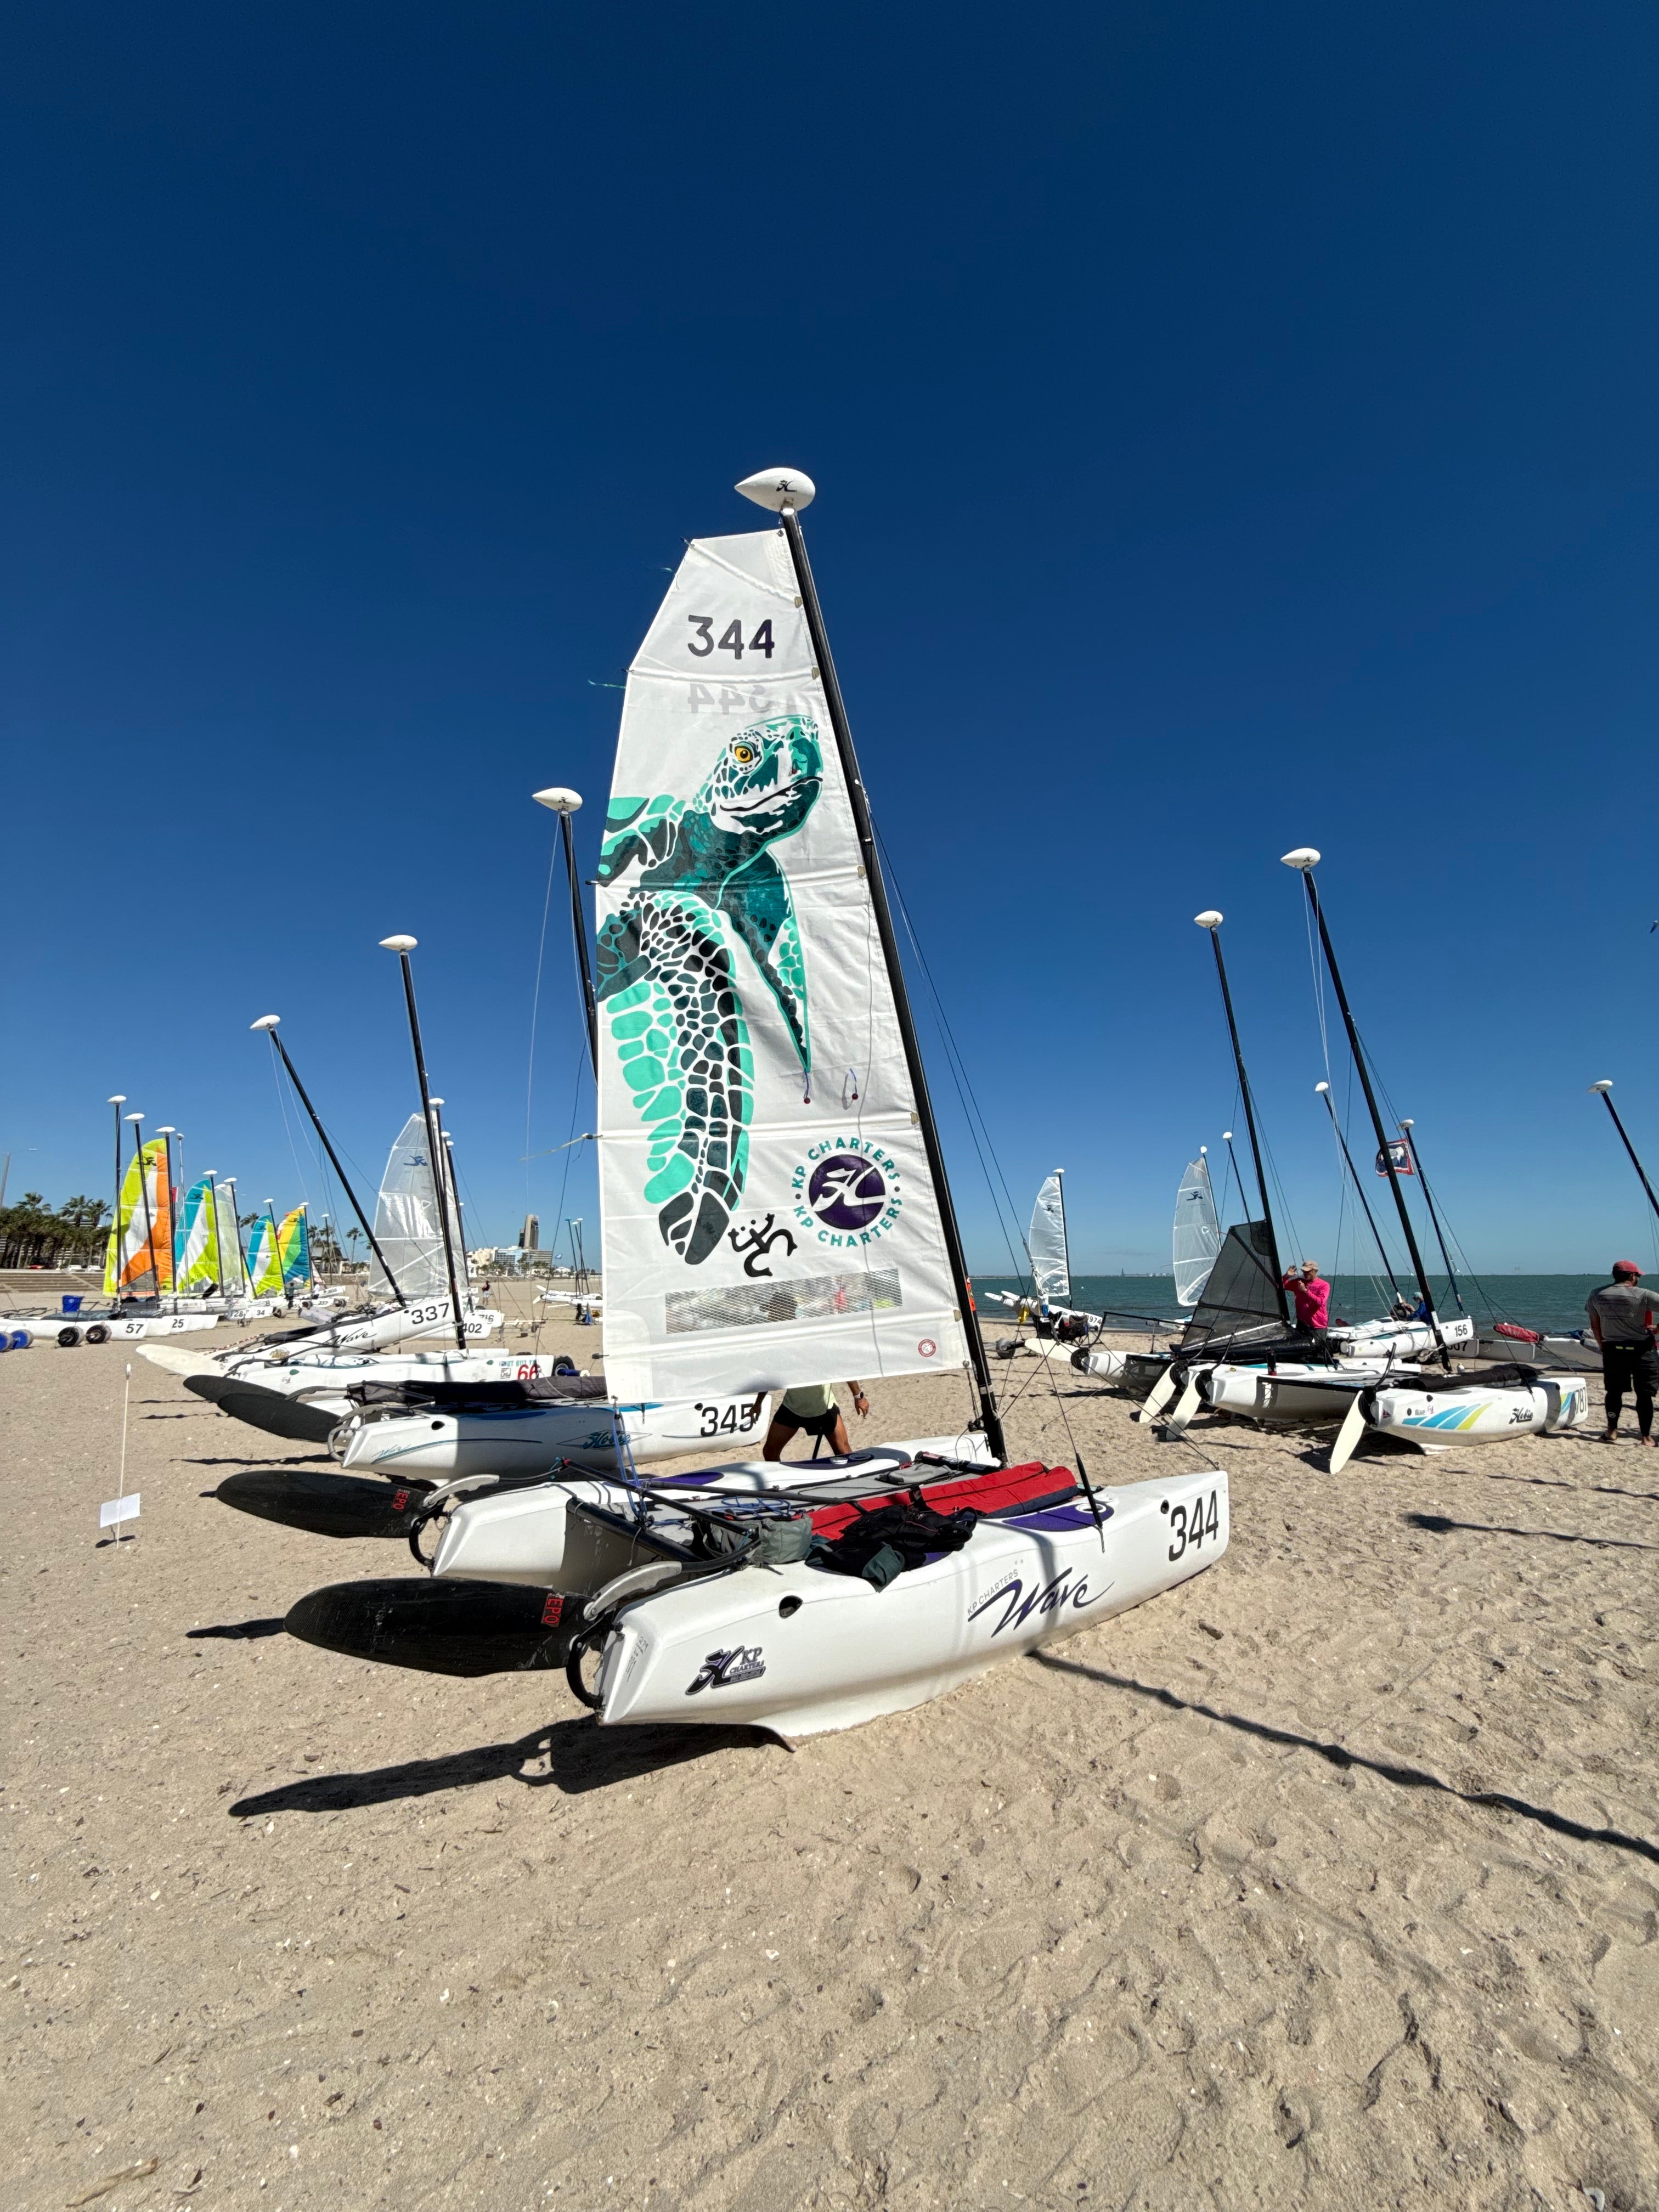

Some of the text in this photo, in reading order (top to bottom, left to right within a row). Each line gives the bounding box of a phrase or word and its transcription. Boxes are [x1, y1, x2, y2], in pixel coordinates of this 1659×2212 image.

[687, 614, 775, 659] 344
[792, 1137, 900, 1189] KP CHARTERS
[794, 1198, 902, 1247] KP CHARTERS
[411, 1302, 449, 1324] 337
[126, 1323, 144, 1334] 57
[172, 1319, 184, 1328] 25
[462, 1323, 482, 1333] 402
[1454, 1324, 1468, 1337] 156
[323, 1328, 377, 1344] Wave
[701, 1403, 755, 1437] 345
[1509, 1407, 1533, 1424] Hobie
[393, 1493, 409, 1509] EPO
[1169, 1490, 1219, 1562] 344
[968, 1569, 1018, 1616] KP CHARTERS
[968, 1567, 1115, 1638] Wave
[544, 1599, 563, 1623] EPO
[740, 1647, 763, 1666] KP
[729, 1660, 764, 1674] CHARTERS
